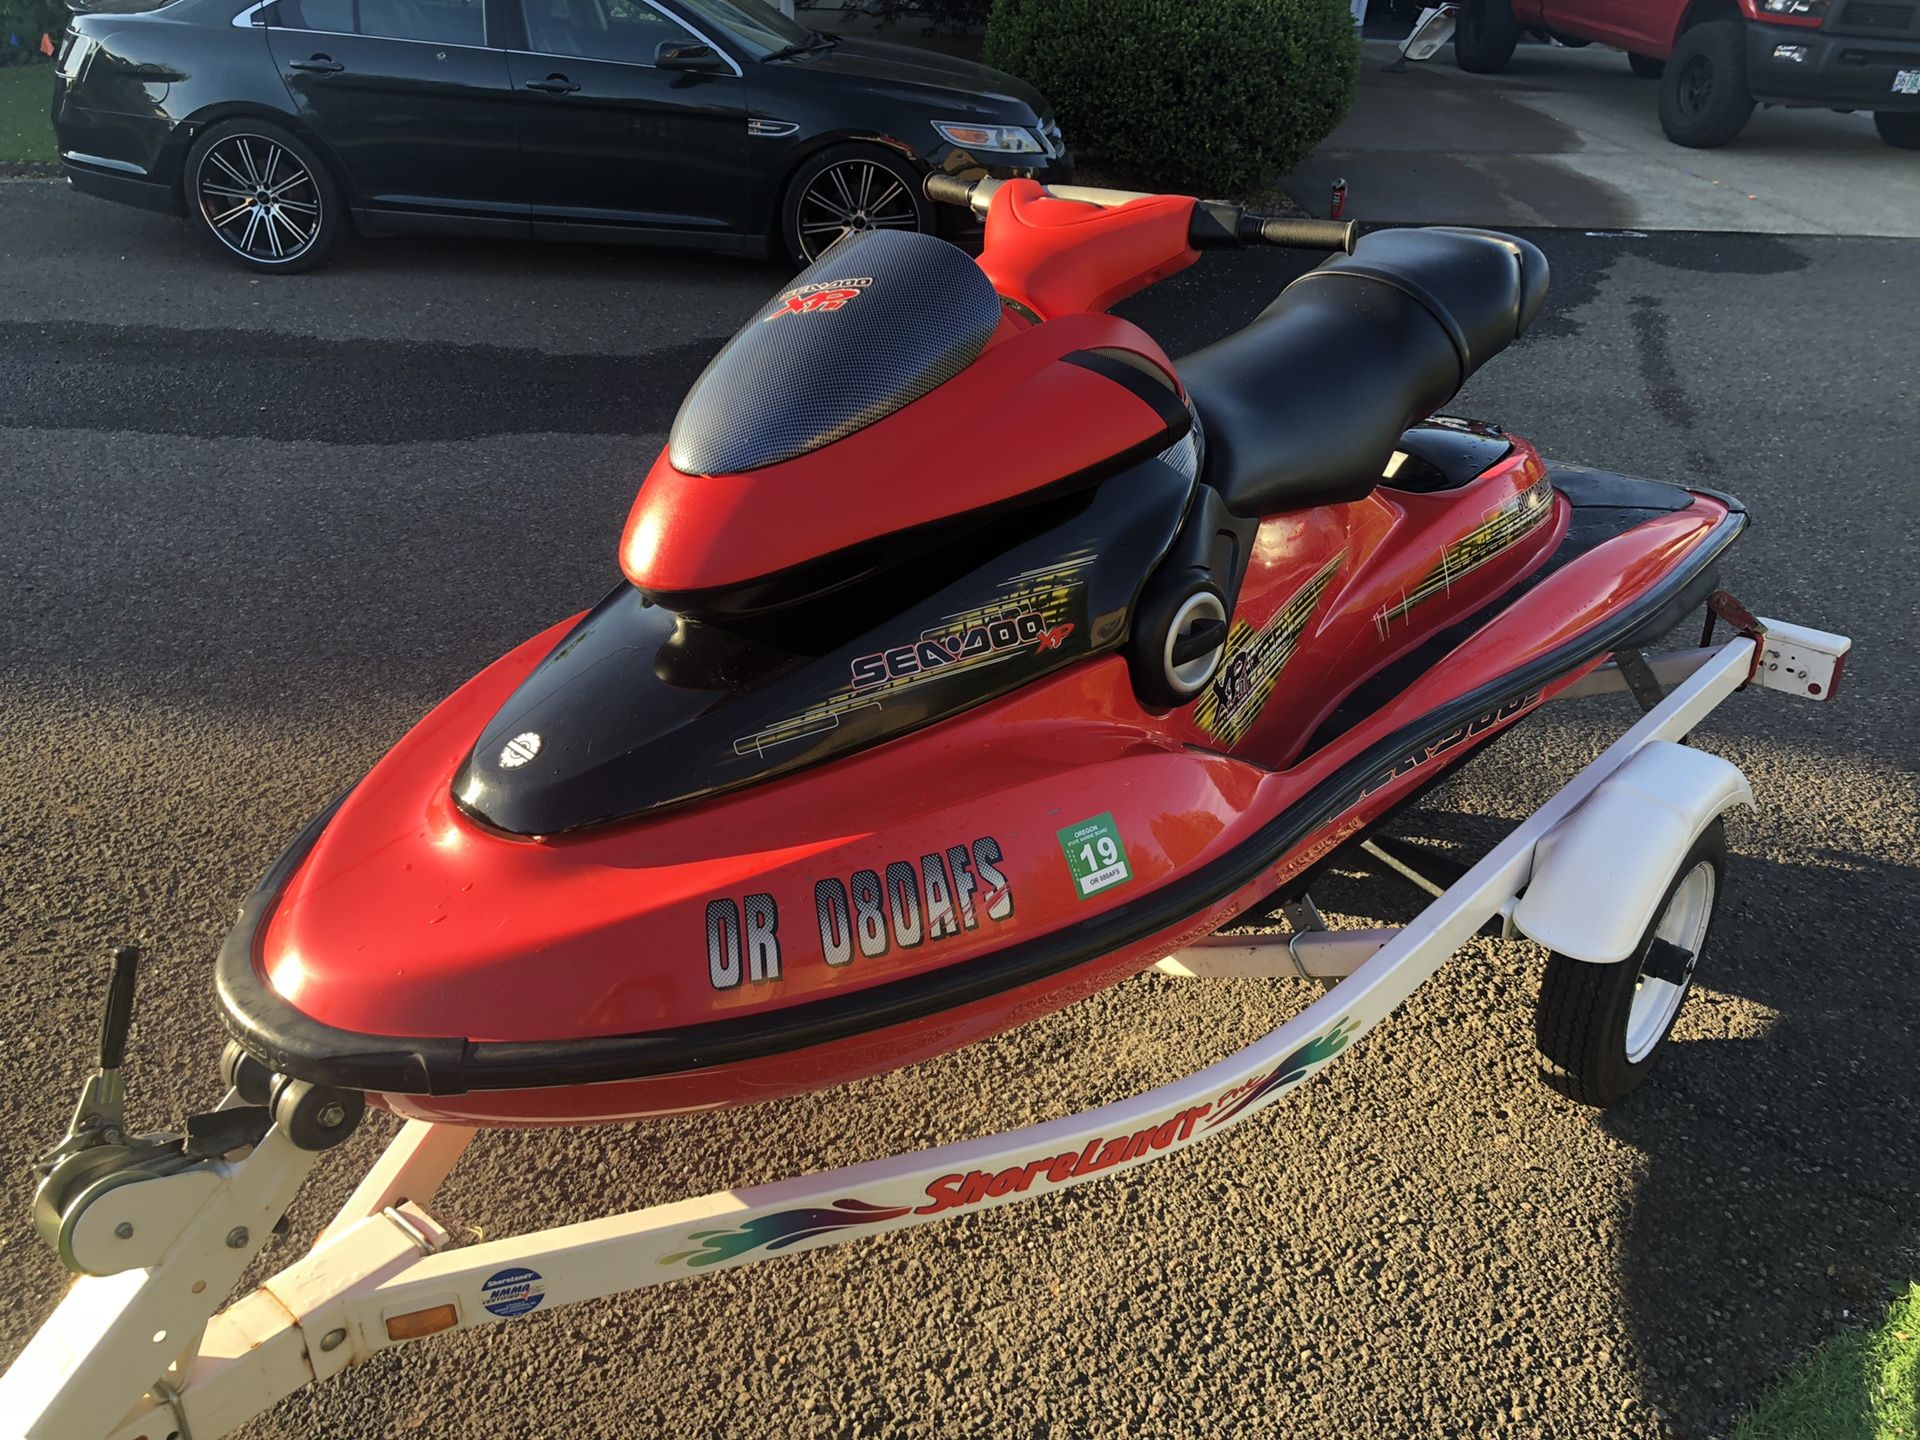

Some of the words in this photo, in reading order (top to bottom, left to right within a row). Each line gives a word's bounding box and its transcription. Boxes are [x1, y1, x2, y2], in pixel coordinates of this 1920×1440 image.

[1074, 825, 1098, 838] OREGON
[1080, 836, 1118, 872] 19
[1090, 877, 1099, 885] OR
[705, 893, 784, 991] OR
[490, 1284, 530, 1298] NMMA
